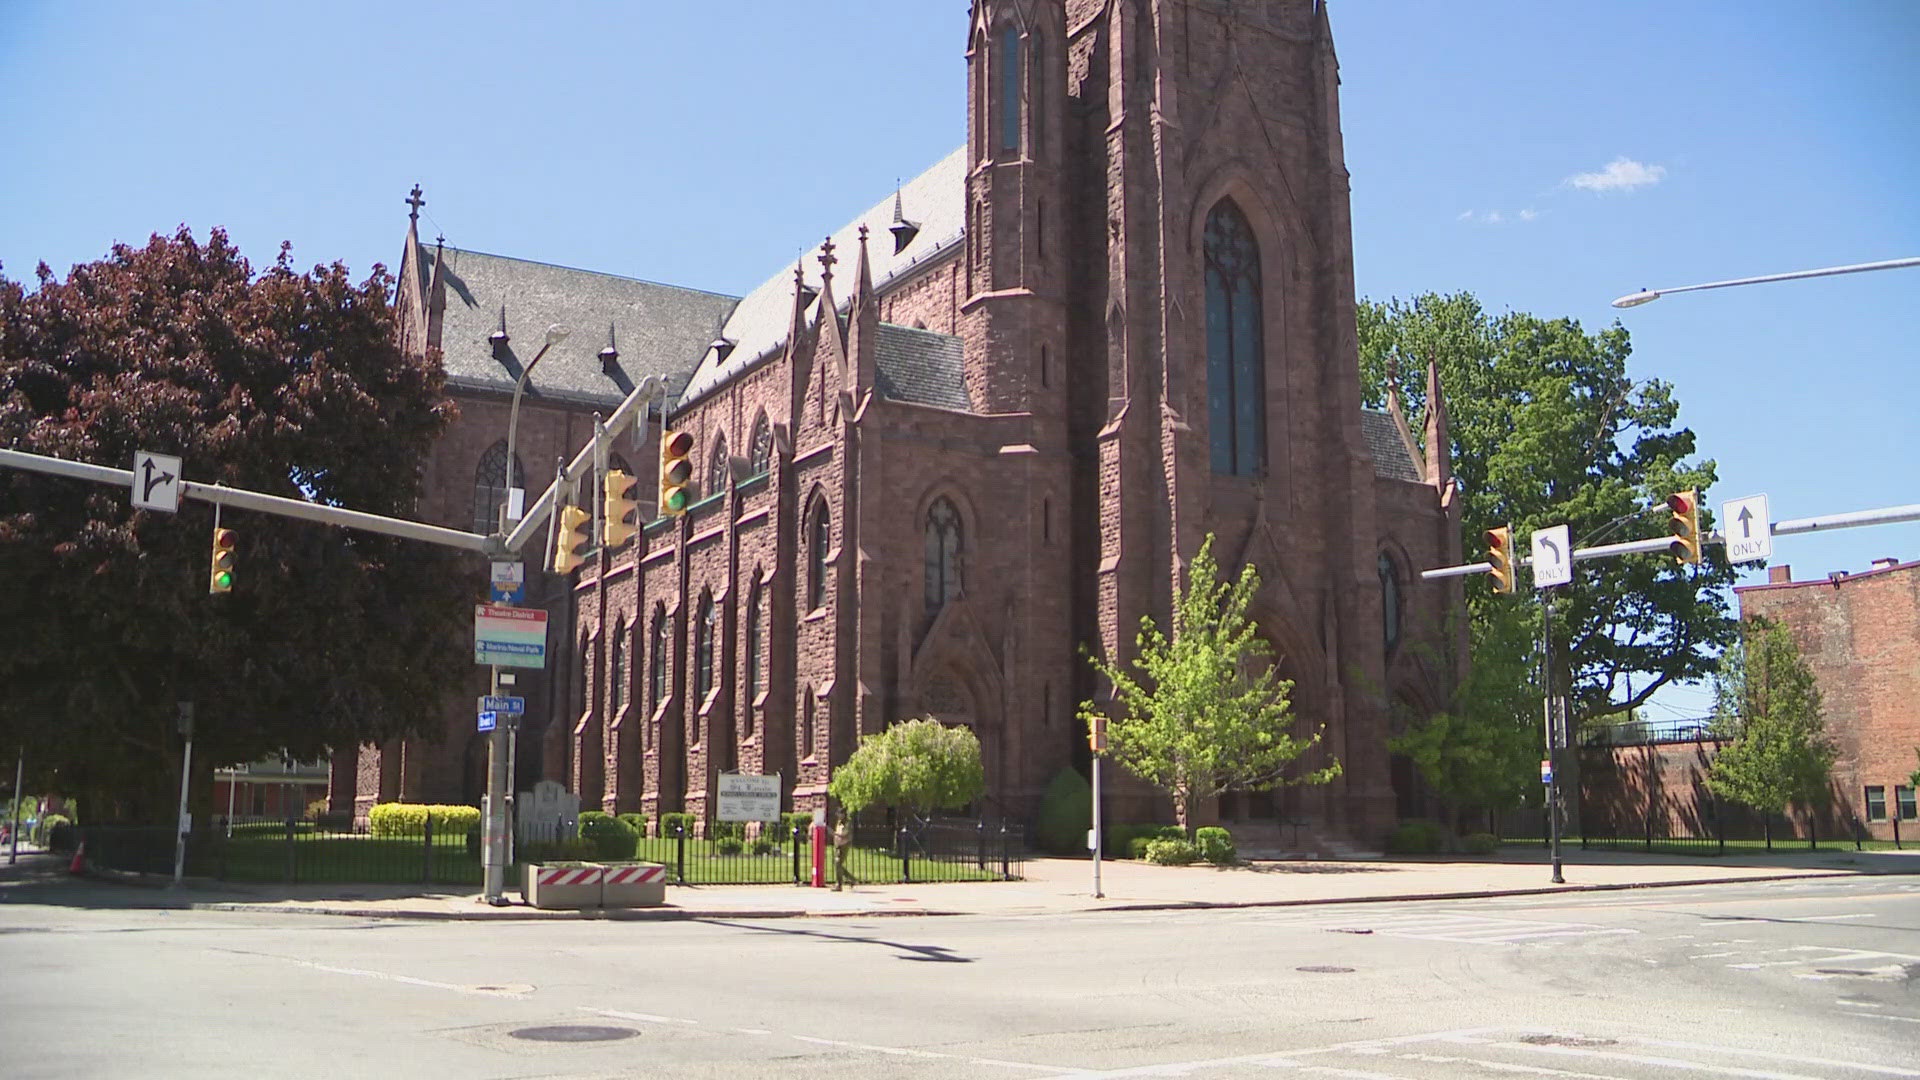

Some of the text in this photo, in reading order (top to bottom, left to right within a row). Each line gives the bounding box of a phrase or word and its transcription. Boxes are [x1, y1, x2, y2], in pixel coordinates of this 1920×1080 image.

[1733, 540, 1762, 556] ONLY
[1538, 567, 1564, 580] ONLY
[512, 609, 535, 619] District
[486, 698, 521, 710] Main St
